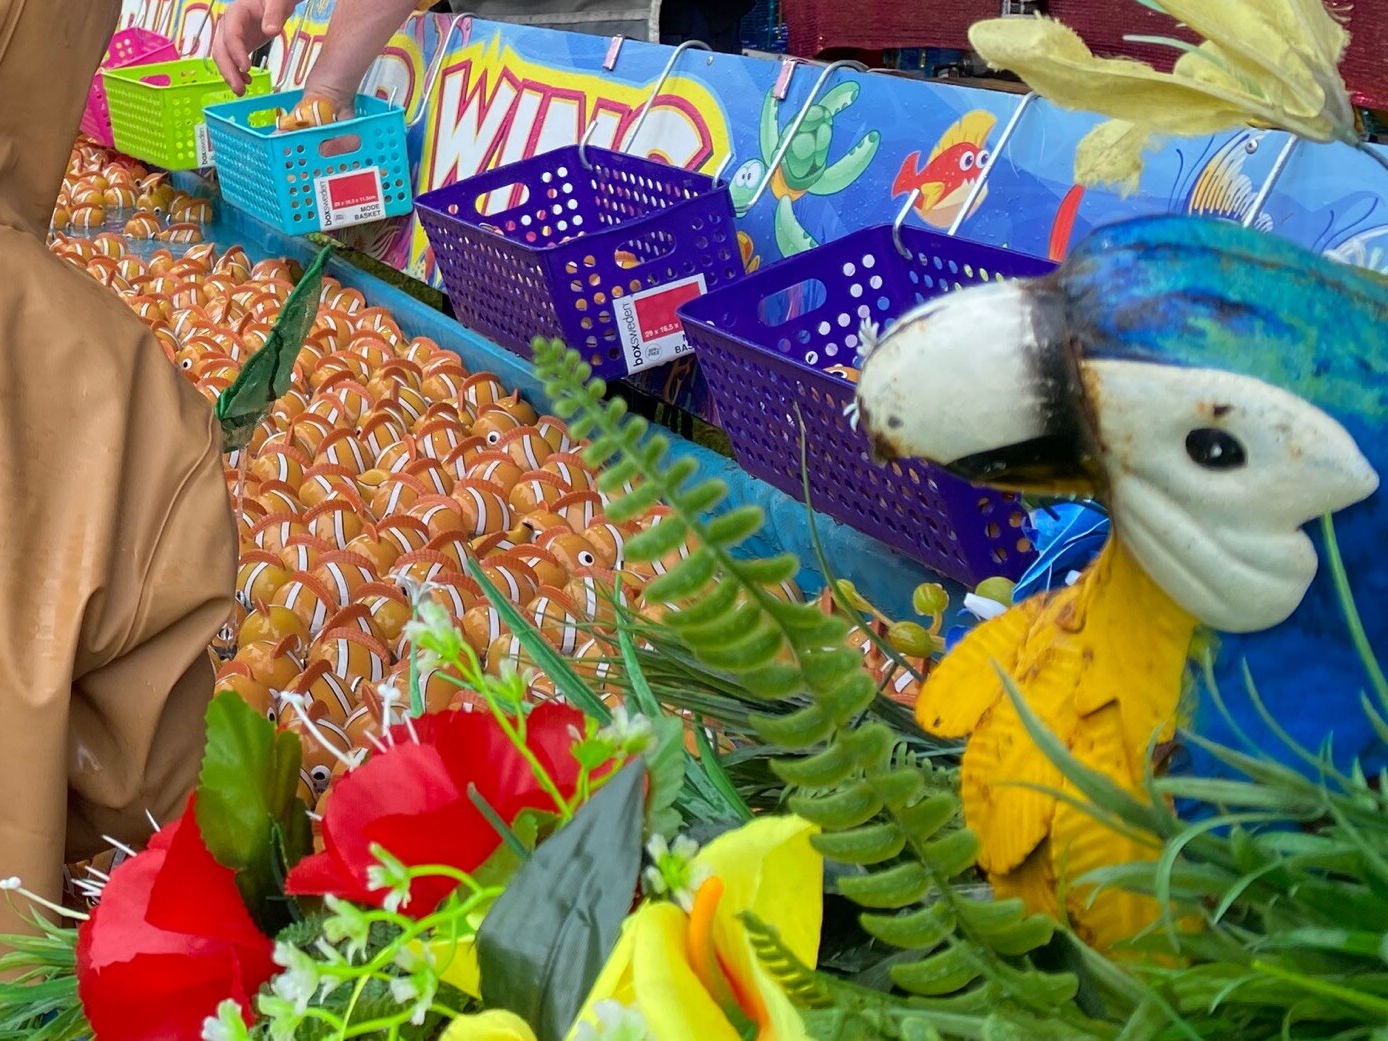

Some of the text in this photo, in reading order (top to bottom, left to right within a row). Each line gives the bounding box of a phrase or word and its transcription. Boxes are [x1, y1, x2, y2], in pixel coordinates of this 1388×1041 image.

[360, 203, 380, 212] MODE
[354, 210, 381, 221] BASKET
[622, 302, 643, 367] boxsweden
